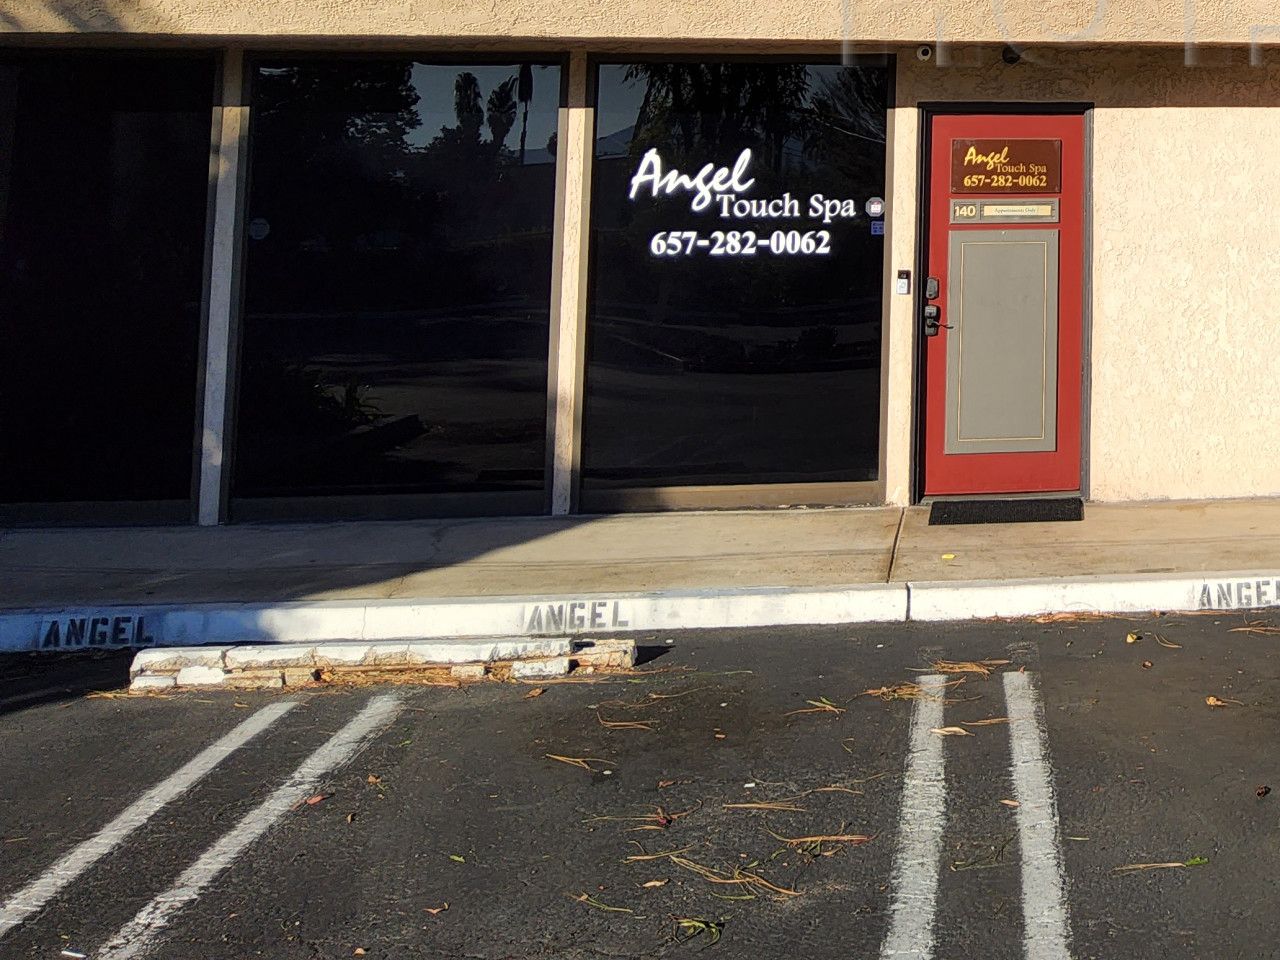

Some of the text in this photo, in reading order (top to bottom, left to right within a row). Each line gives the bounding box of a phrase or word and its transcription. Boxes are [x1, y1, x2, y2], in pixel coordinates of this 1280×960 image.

[963, 145, 1010, 170] Angel
[995, 163, 1047, 175] Touch Spa
[628, 147, 756, 211] Angel
[963, 174, 1048, 188] 657-282-0062
[716, 192, 801, 217] Touch
[808, 193, 857, 223] Spa
[954, 205, 977, 218] 140
[650, 229, 832, 256] 657-282-0062
[526, 601, 629, 632] ANGEL
[42, 616, 154, 648] ANGEL
